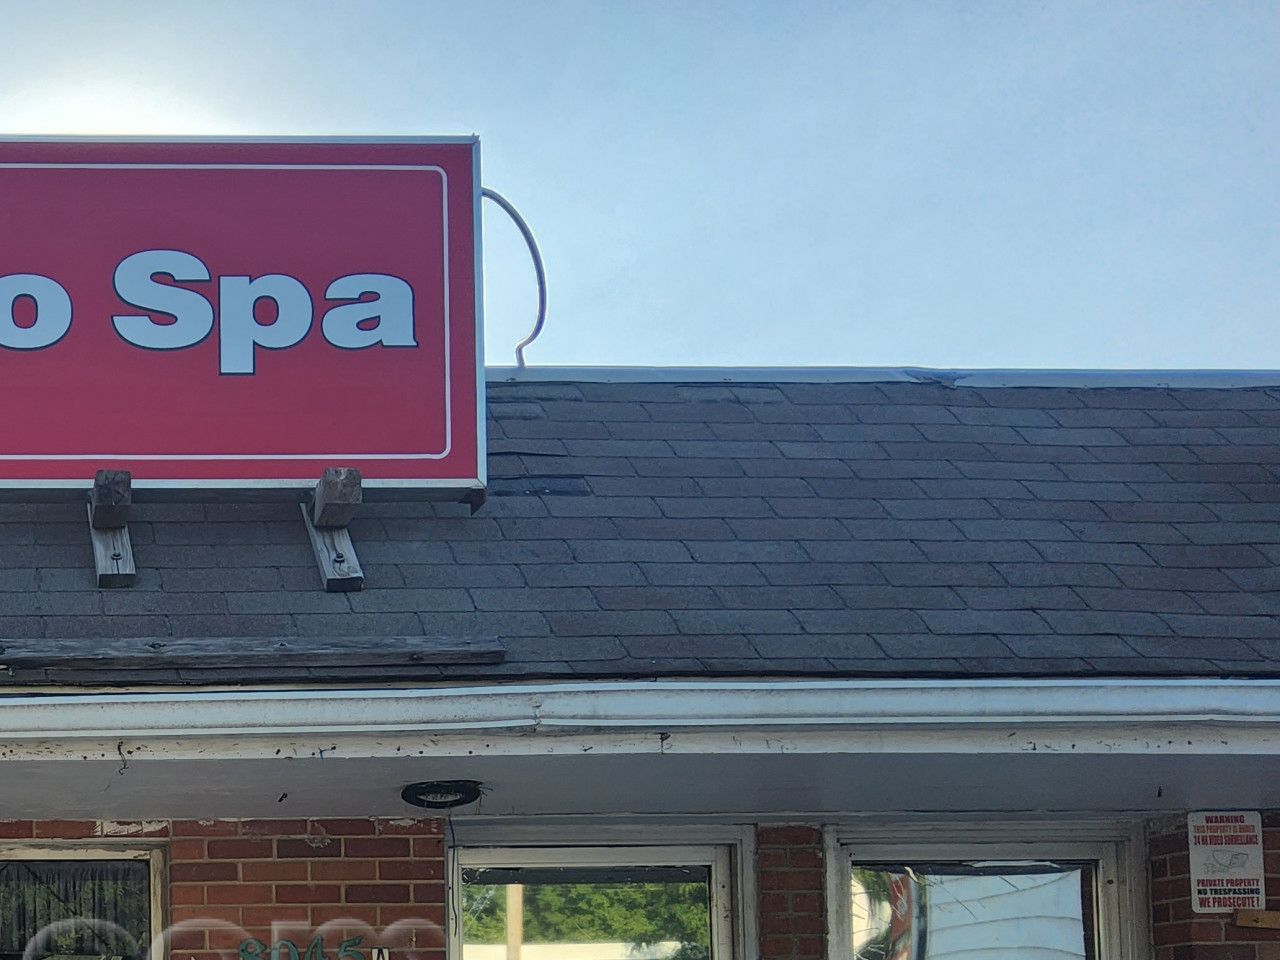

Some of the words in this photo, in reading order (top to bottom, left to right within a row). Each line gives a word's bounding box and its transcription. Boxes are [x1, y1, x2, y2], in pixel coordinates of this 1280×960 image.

[109, 247, 420, 376] Spa
[1205, 815, 1245, 824] WARNING
[1197, 879, 1225, 887] PRIVATE
[1226, 879, 1260, 887] PROPERTY
[1198, 897, 1211, 908] WE
